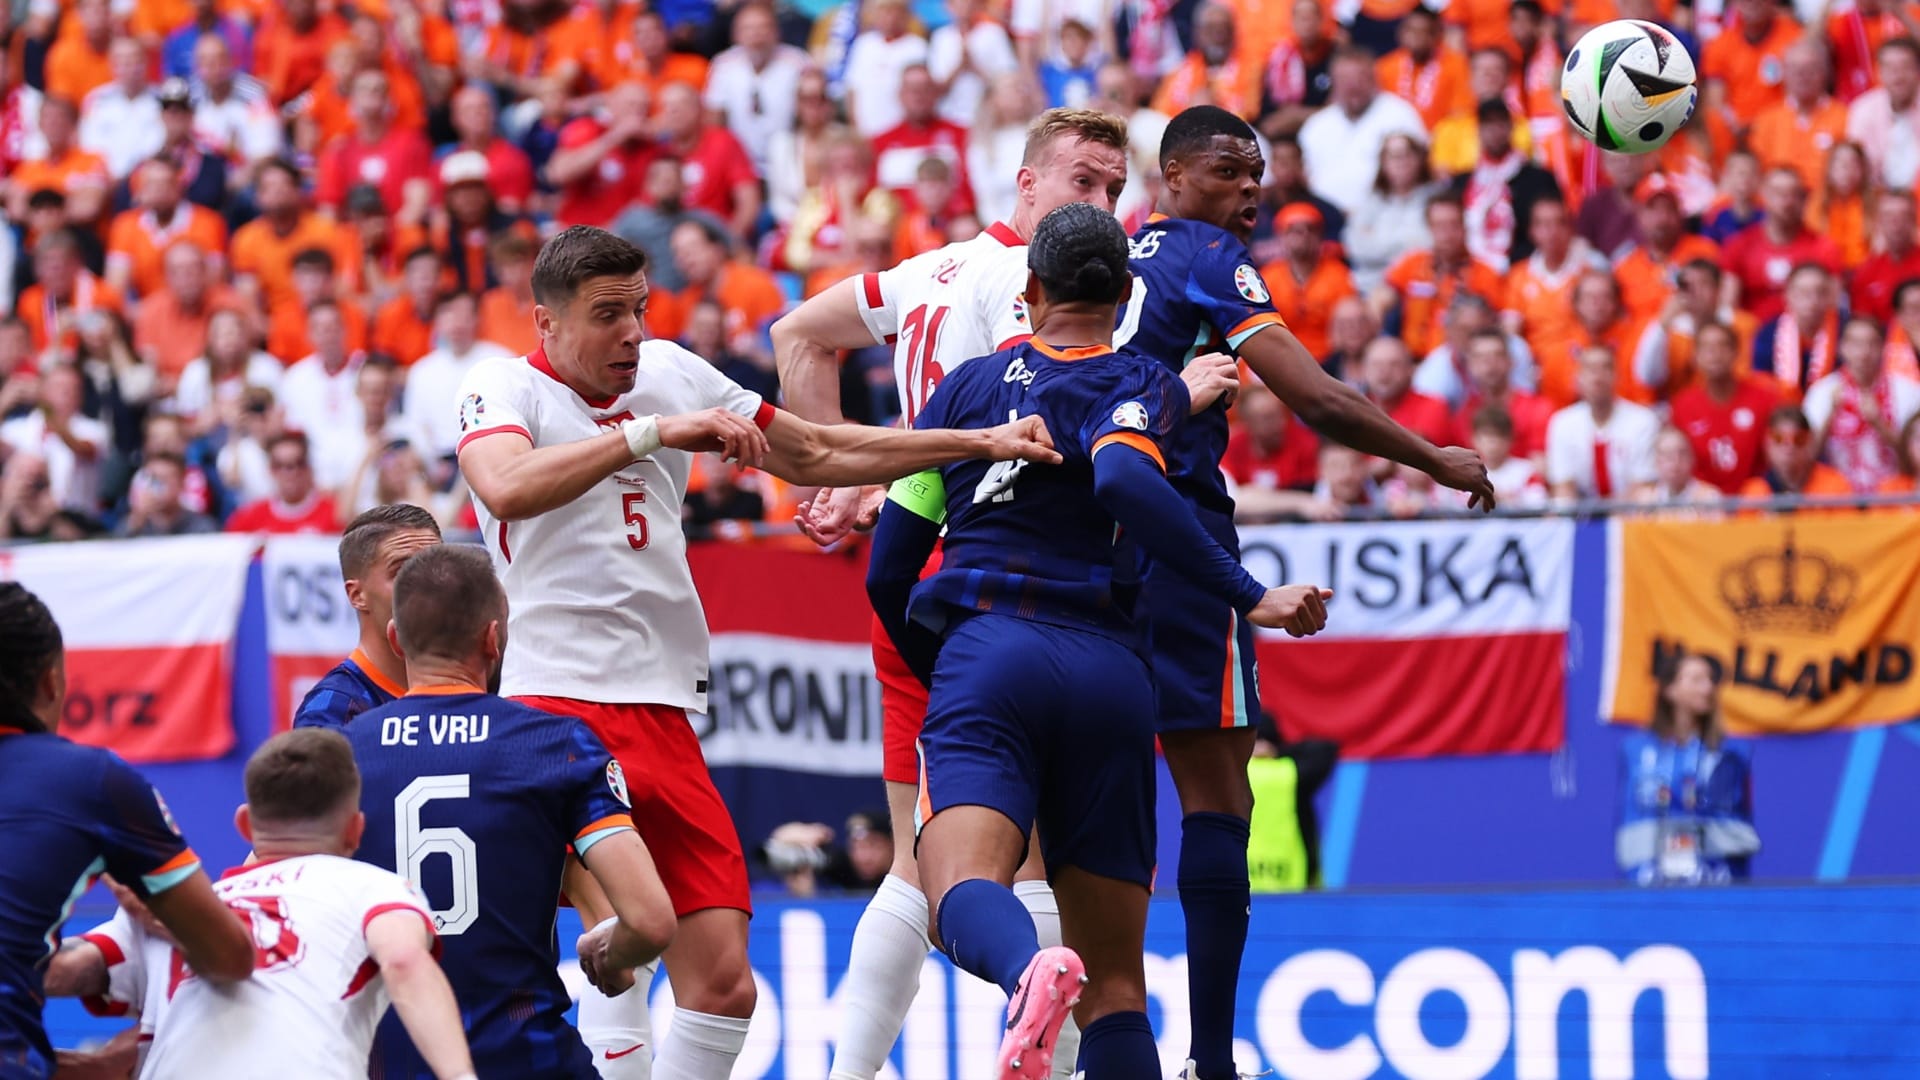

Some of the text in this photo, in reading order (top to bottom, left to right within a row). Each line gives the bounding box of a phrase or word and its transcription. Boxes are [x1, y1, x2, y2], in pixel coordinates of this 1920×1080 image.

[902, 303, 950, 430] 16
[622, 491, 649, 551] 5
[277, 564, 347, 625] OS
[378, 715, 420, 746] DE
[698, 660, 885, 742] RONI
[394, 773, 479, 935] 6
